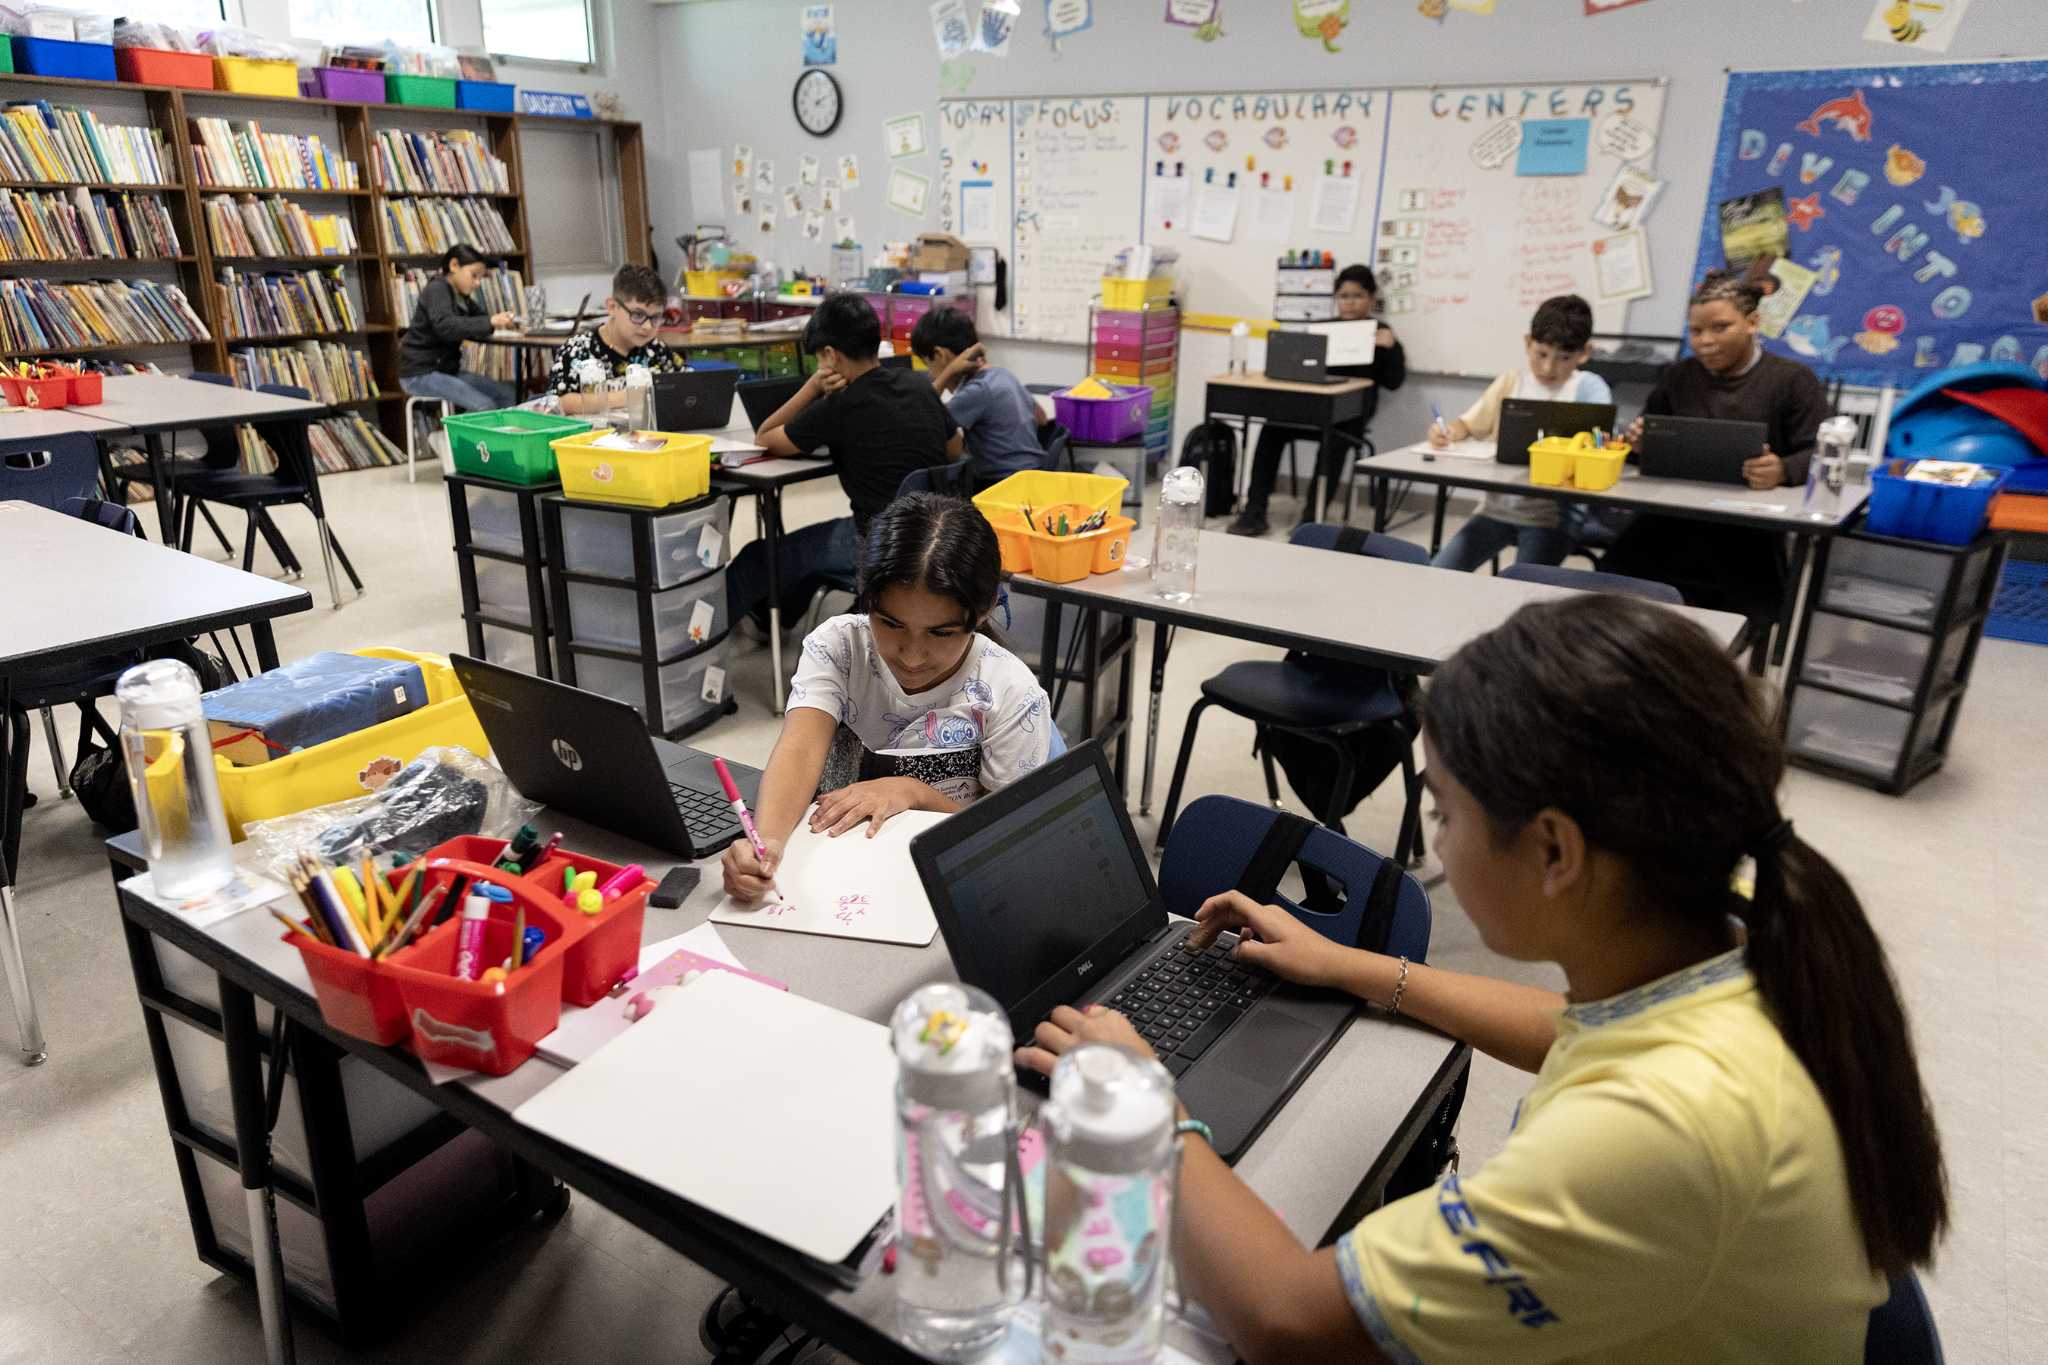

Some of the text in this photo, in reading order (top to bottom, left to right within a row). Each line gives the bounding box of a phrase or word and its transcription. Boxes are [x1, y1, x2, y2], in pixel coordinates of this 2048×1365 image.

[522, 93, 576, 113] DAUGHTRY
[940, 100, 1006, 129] TODAY
[1165, 93, 1375, 121] VOCABULARY
[1431, 86, 1634, 121] CENTERS
[1739, 129, 1870, 206] DIVE
[1871, 204, 1972, 320] INTO
[1077, 959, 1094, 977] DELL
